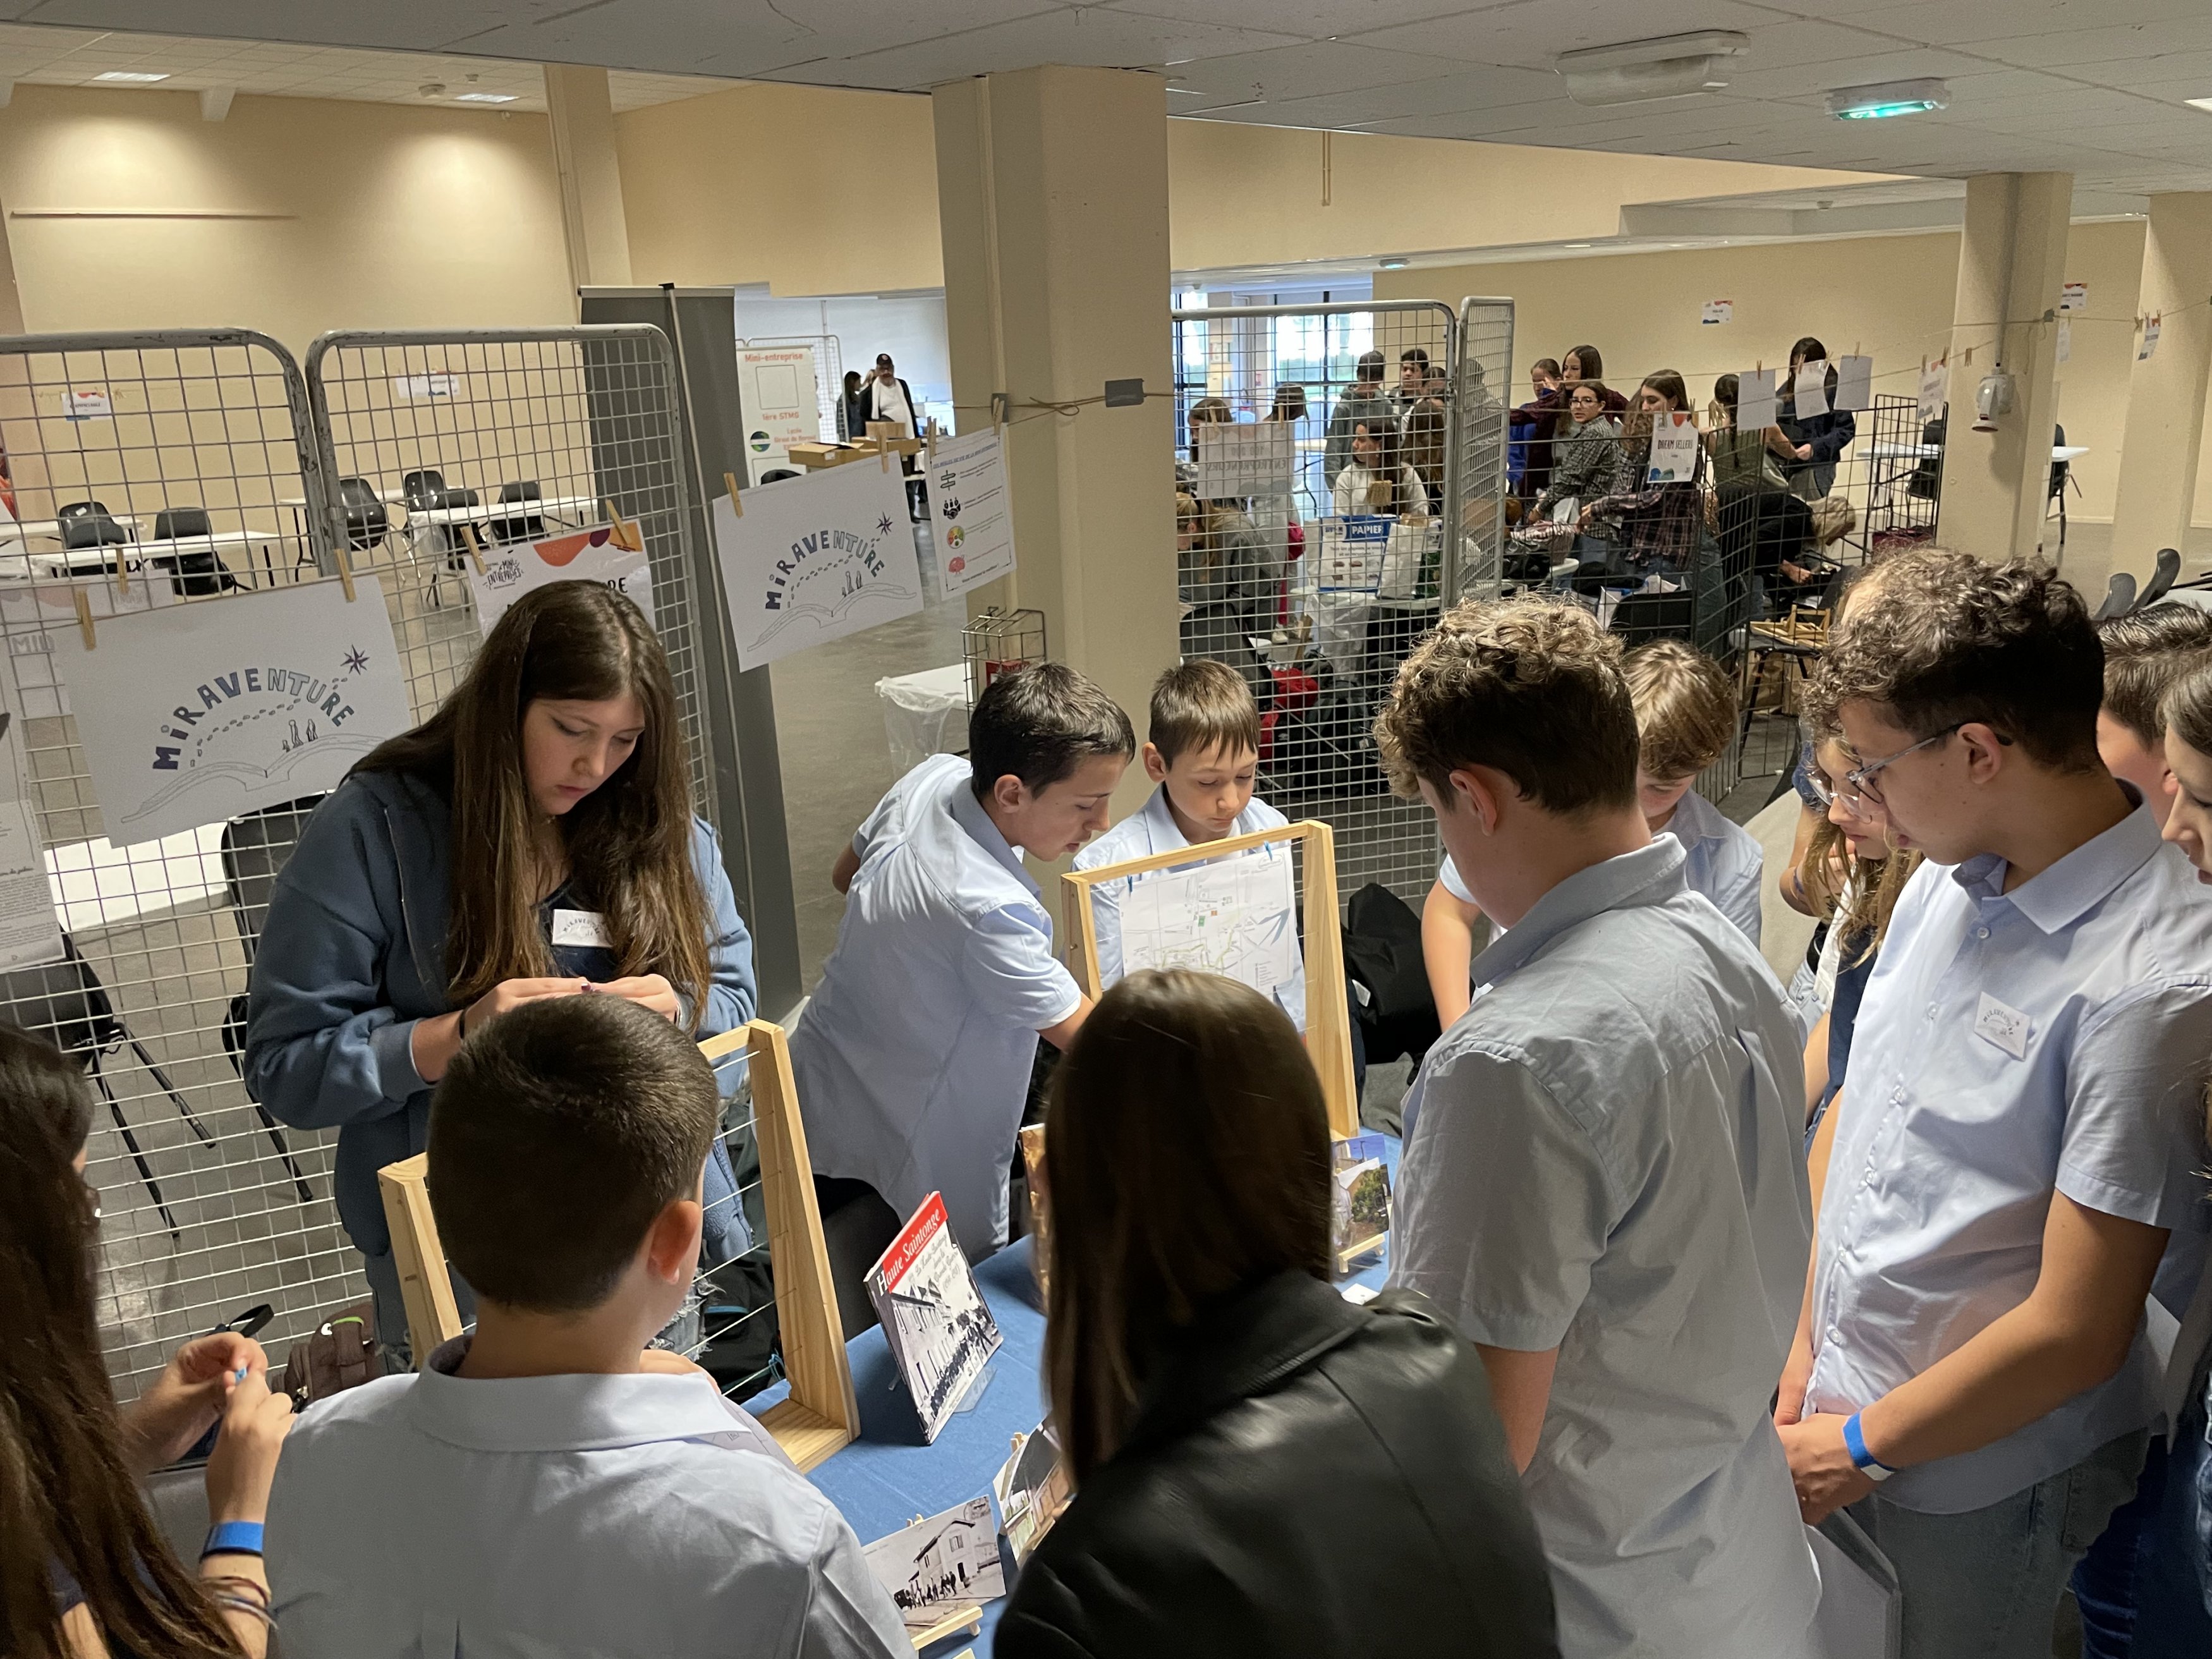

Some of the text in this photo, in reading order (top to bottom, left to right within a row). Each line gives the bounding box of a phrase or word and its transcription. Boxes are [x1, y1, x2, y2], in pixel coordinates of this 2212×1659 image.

[744, 353, 803, 363] Mini-entreprise
[779, 411, 799, 420] STMG
[1657, 439, 1693, 450] DREAM SELLERS
[876, 1256, 904, 1296] Haute
[902, 1208, 941, 1263] Saintonge
